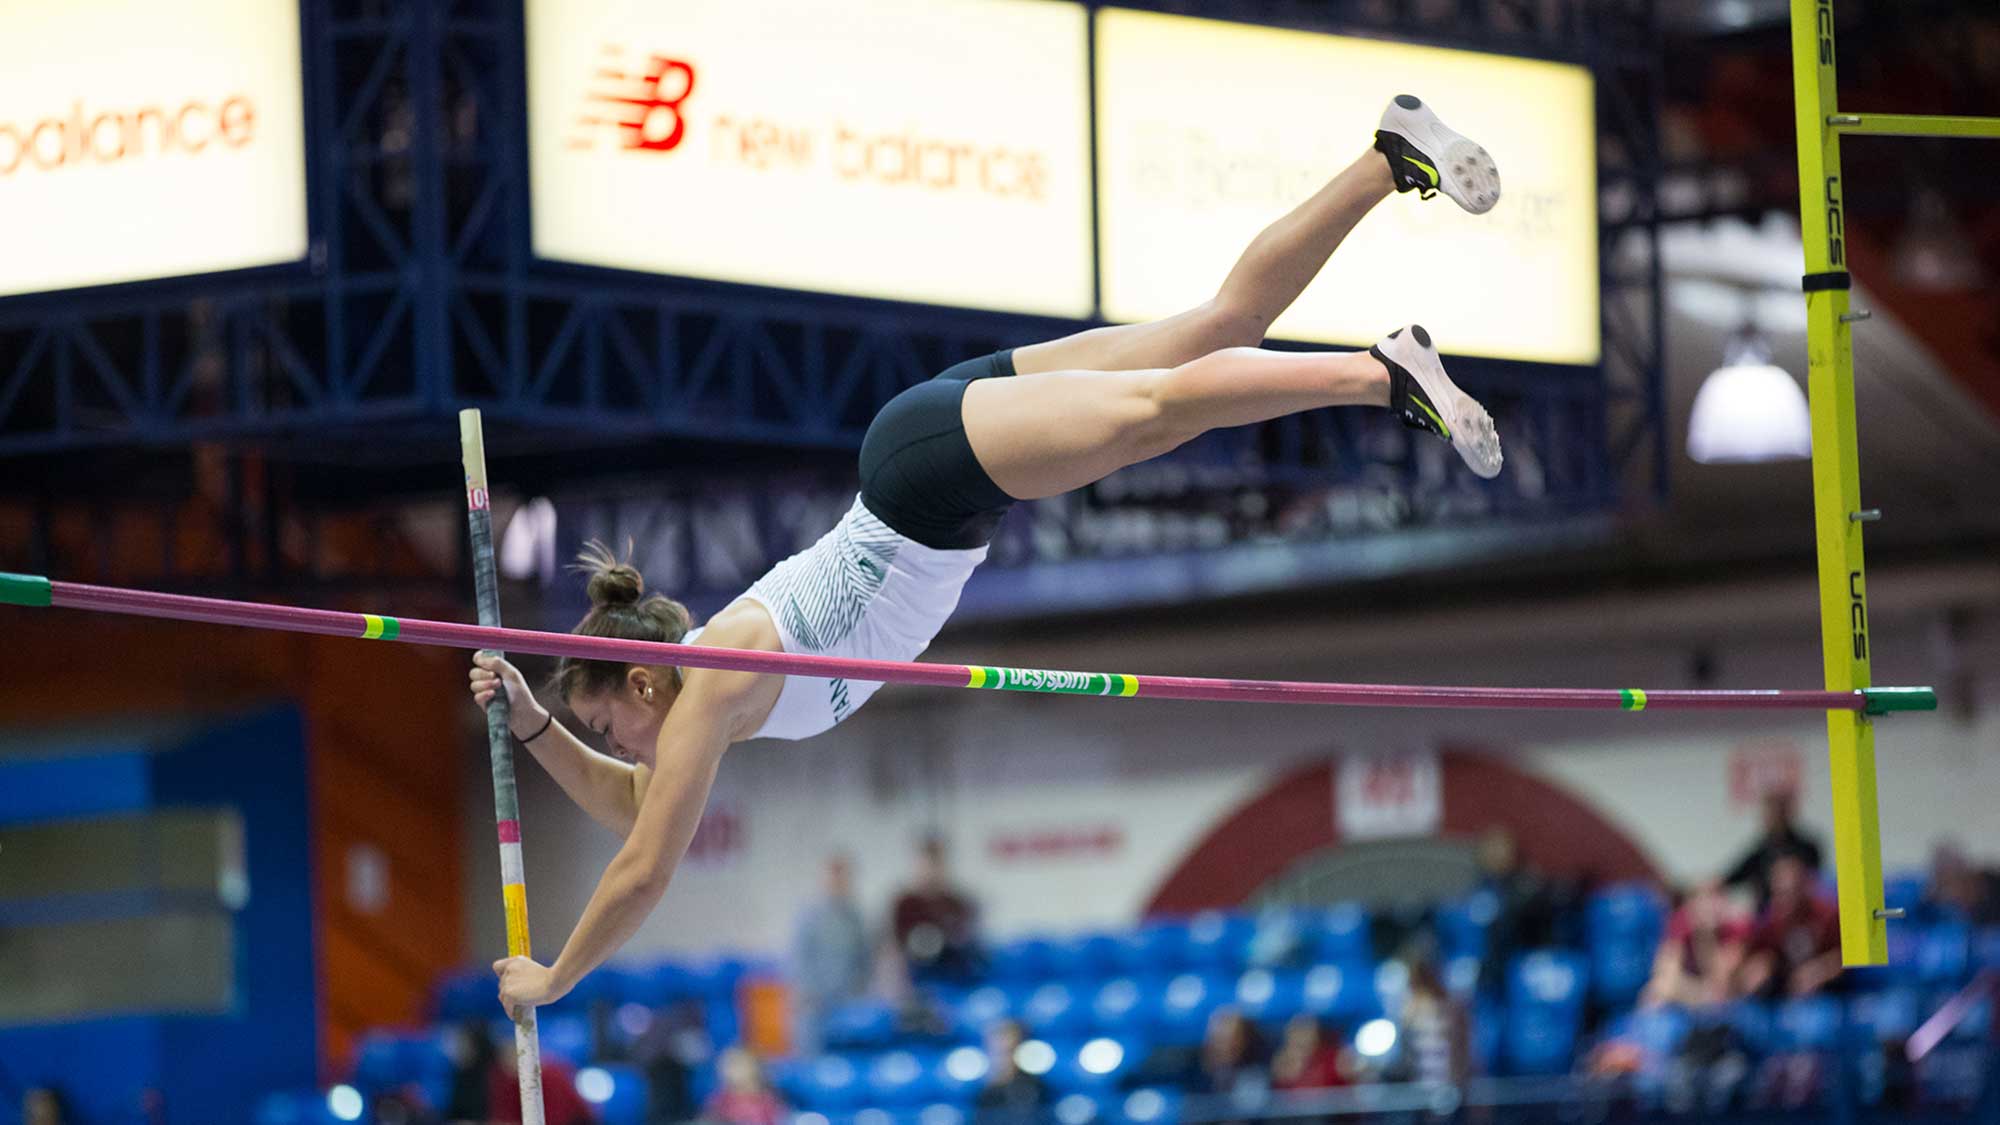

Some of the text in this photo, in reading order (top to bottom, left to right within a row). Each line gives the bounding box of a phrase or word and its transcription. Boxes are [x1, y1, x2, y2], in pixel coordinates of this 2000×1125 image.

[1817, 0, 1832, 66] CS
[1826, 176, 1843, 266] UCS
[1850, 571, 1866, 660] UCS
